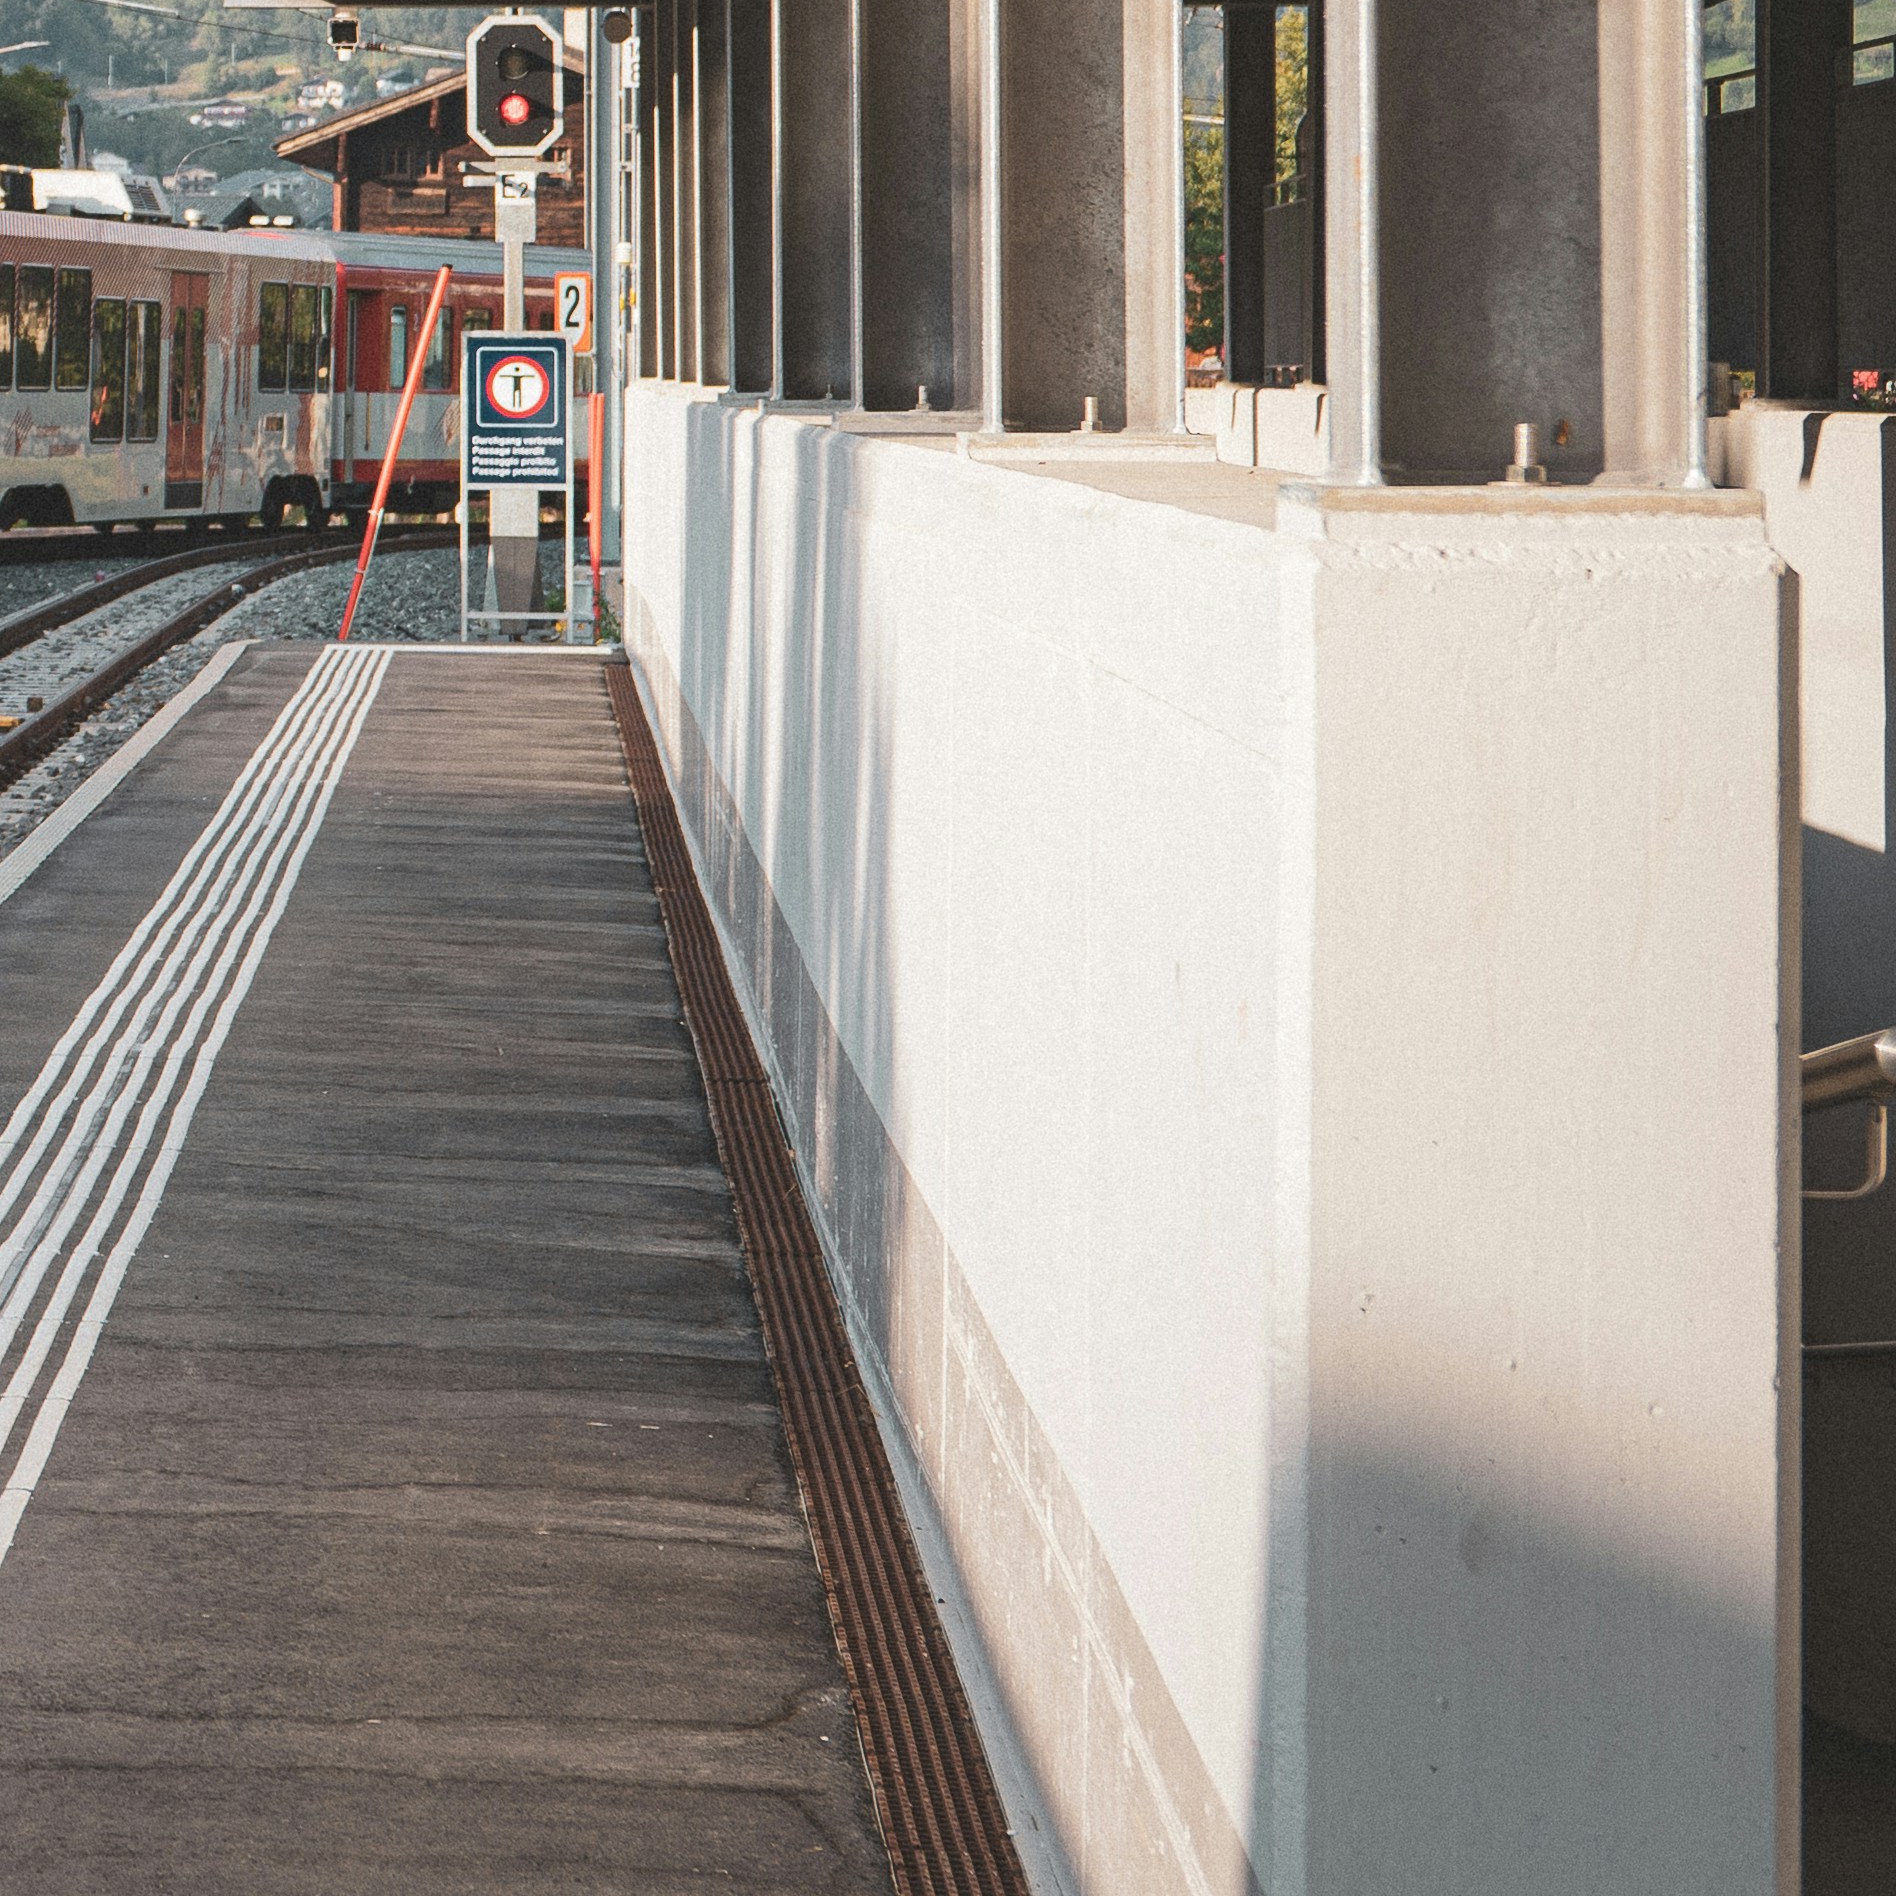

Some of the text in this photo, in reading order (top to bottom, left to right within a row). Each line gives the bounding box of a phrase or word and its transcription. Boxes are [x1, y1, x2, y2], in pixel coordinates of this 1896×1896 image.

[501, 174, 529, 199] E2
[564, 285, 580, 328] 2
[471, 435, 564, 447] Durchgang verboten
[471, 445, 546, 457] Passage interdit
[471, 456, 557, 467] Passaggio proibito
[471, 466, 560, 478] Passage prohibited
